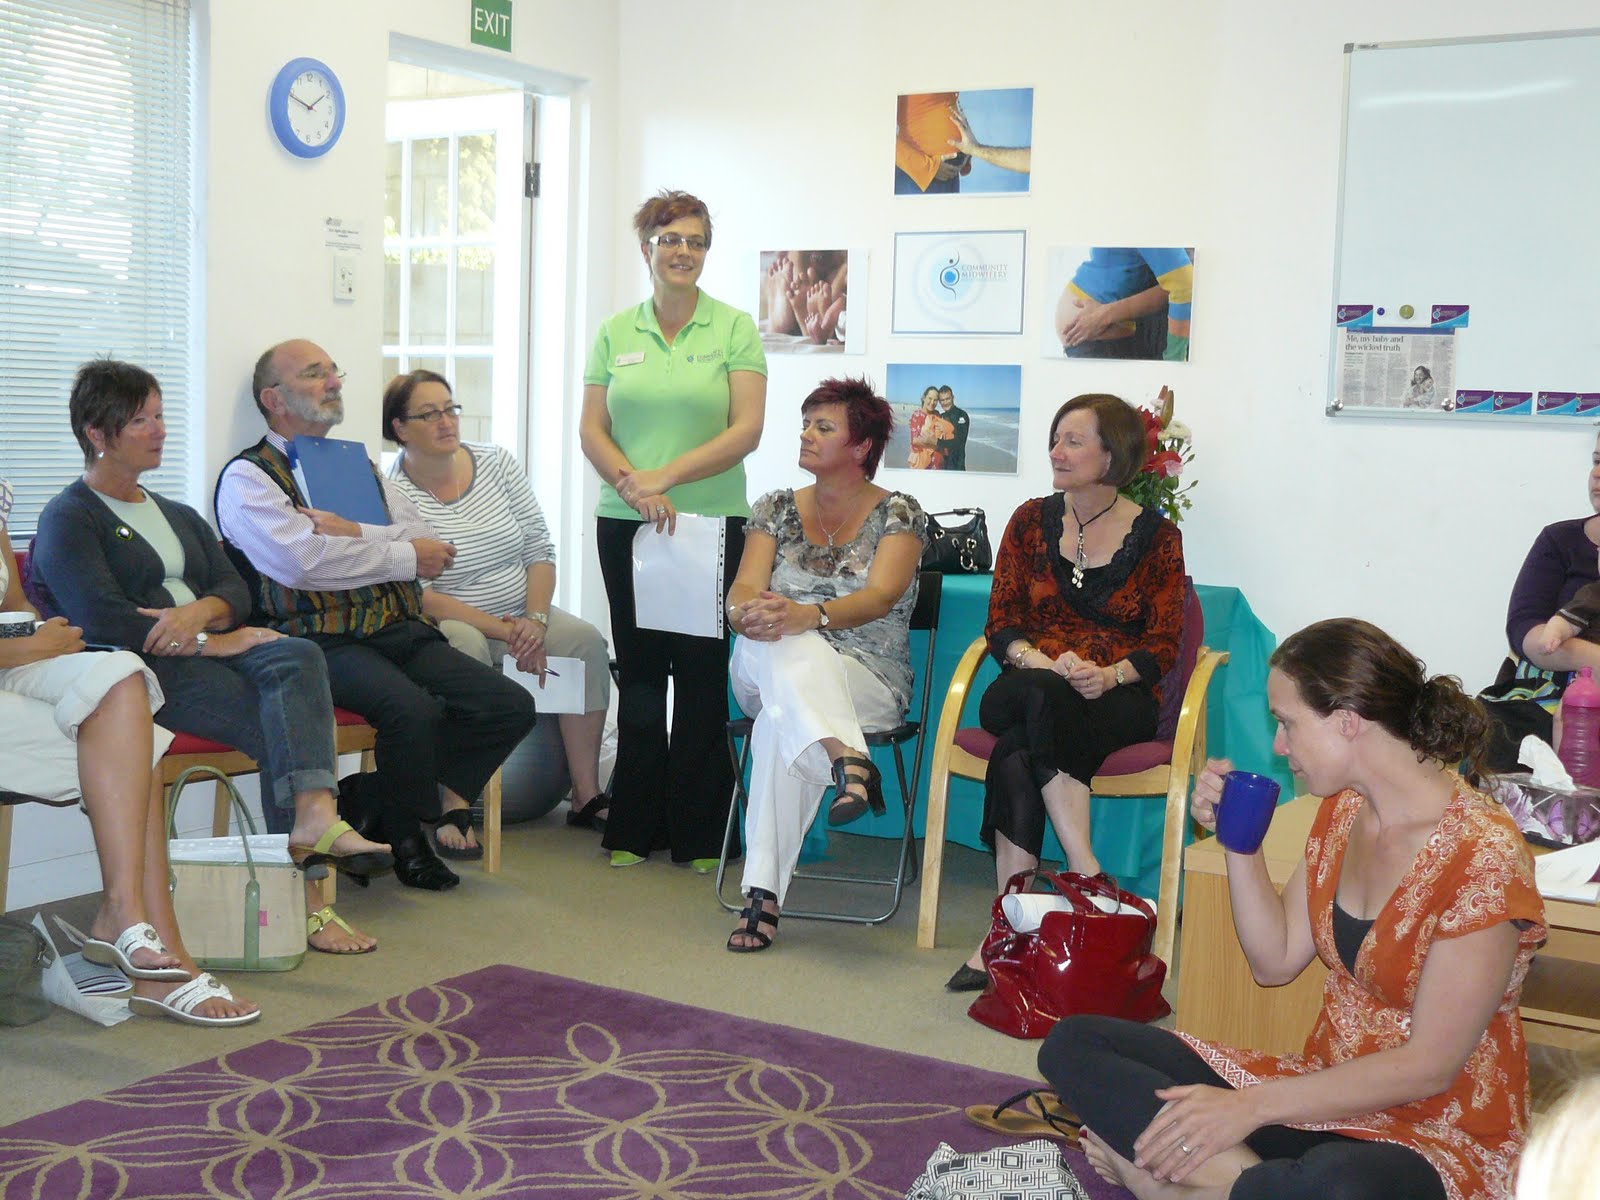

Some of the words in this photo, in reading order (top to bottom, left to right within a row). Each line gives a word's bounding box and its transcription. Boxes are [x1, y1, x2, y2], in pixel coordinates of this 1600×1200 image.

[475, 7, 510, 37] EXIT
[306, 73, 313, 82] 12
[305, 135, 311, 143] 6
[1372, 335, 1390, 343] baby
[1390, 335, 1404, 343] and
[1345, 343, 1357, 351] the
[1357, 343, 1382, 351] wicked
